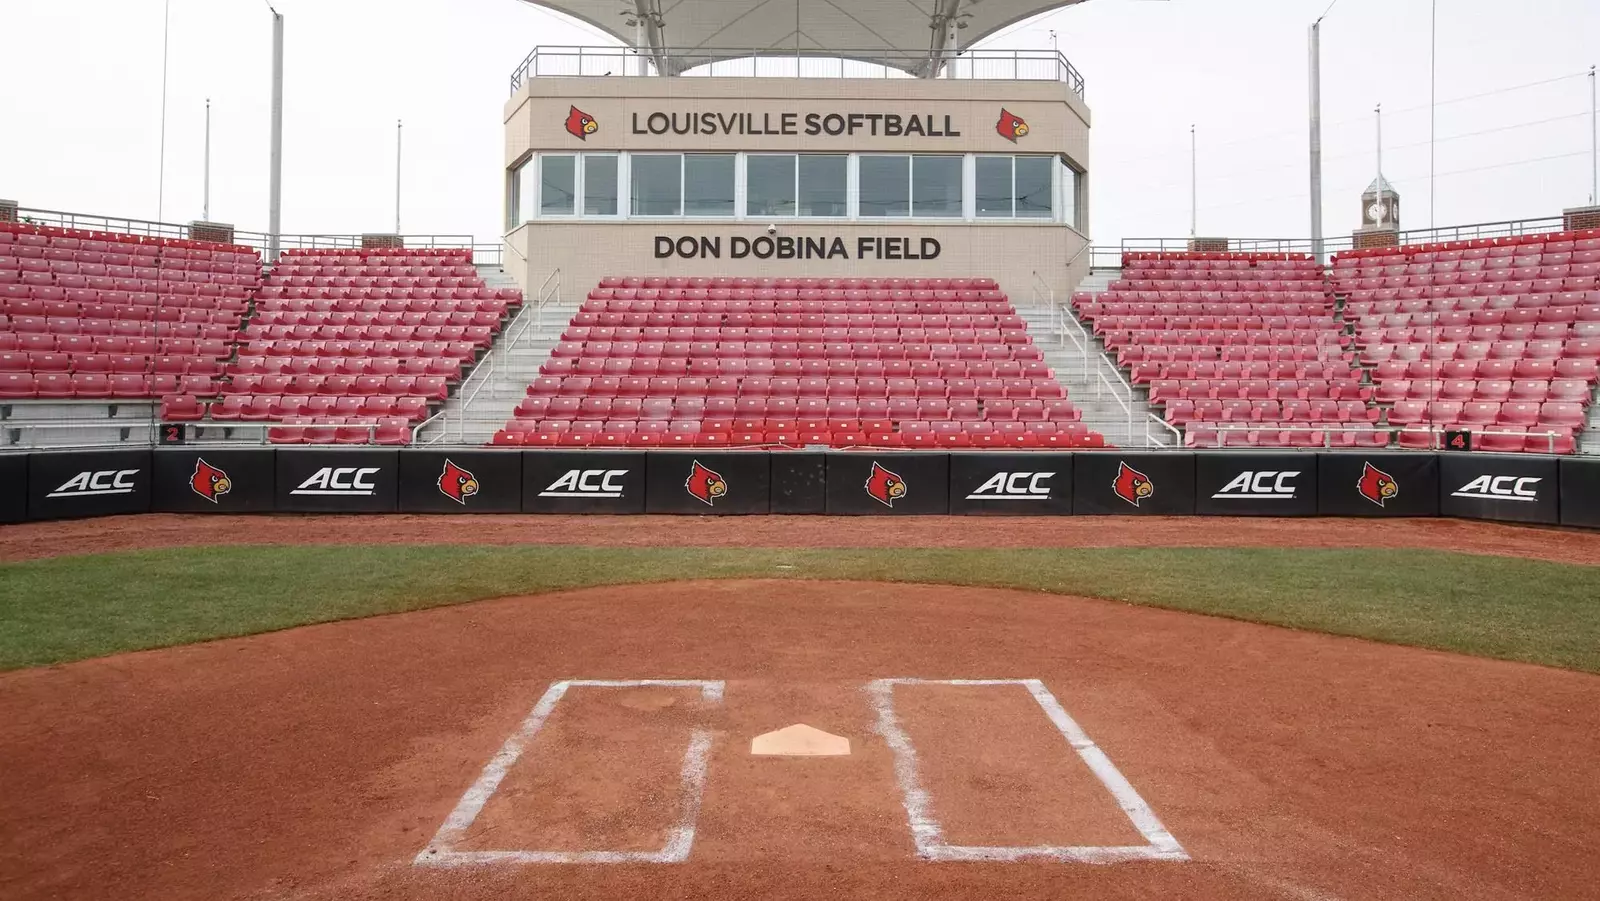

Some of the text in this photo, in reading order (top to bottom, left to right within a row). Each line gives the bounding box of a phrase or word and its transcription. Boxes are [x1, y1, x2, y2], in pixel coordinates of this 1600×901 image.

[632, 112, 961, 137] LOUISVILLE SOFTBALL
[654, 236, 941, 260] DON DOBINA FIELD
[166, 427, 179, 441] 2
[1451, 434, 1465, 448] 4
[55, 470, 140, 491] ACC
[297, 467, 381, 489] ACC
[545, 469, 629, 491] ACC
[972, 471, 1056, 493] ACC
[1218, 471, 1302, 492] ACC
[1457, 474, 1543, 496] ACC
